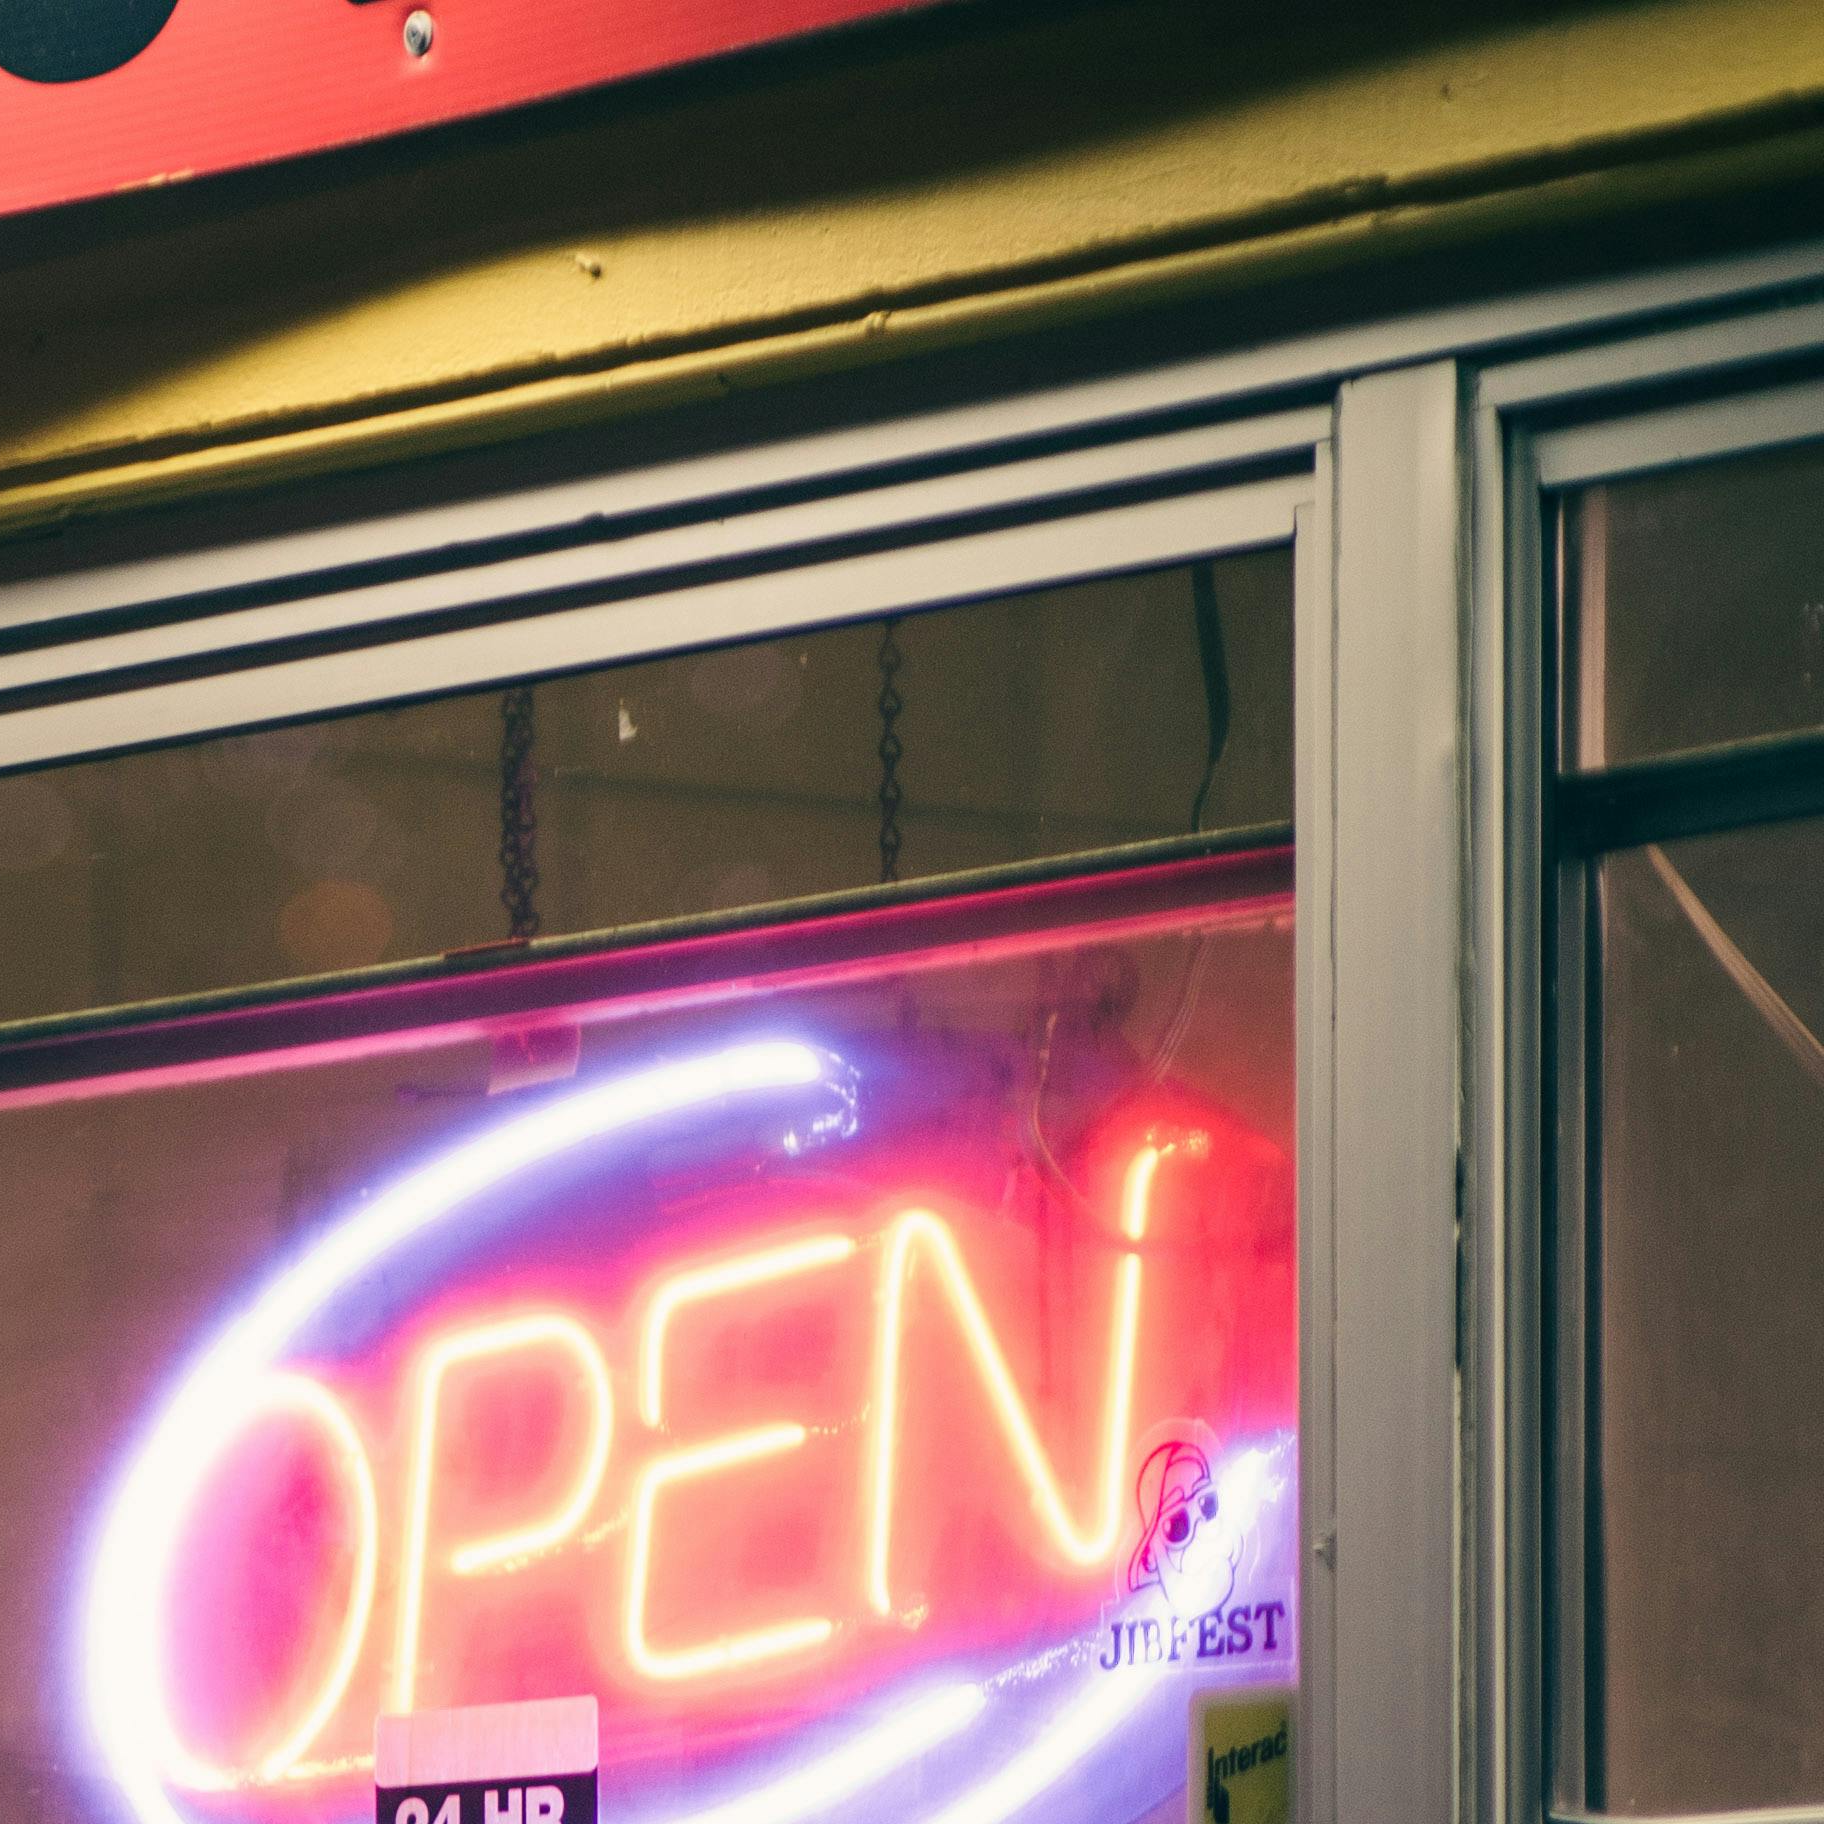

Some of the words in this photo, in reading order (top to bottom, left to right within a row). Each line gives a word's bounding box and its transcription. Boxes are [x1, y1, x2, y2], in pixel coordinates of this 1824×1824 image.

[138, 1135, 1166, 1790] OPEN
[1100, 1601, 1285, 1670] JIBFEST
[1207, 1726, 1288, 1782] Interac
